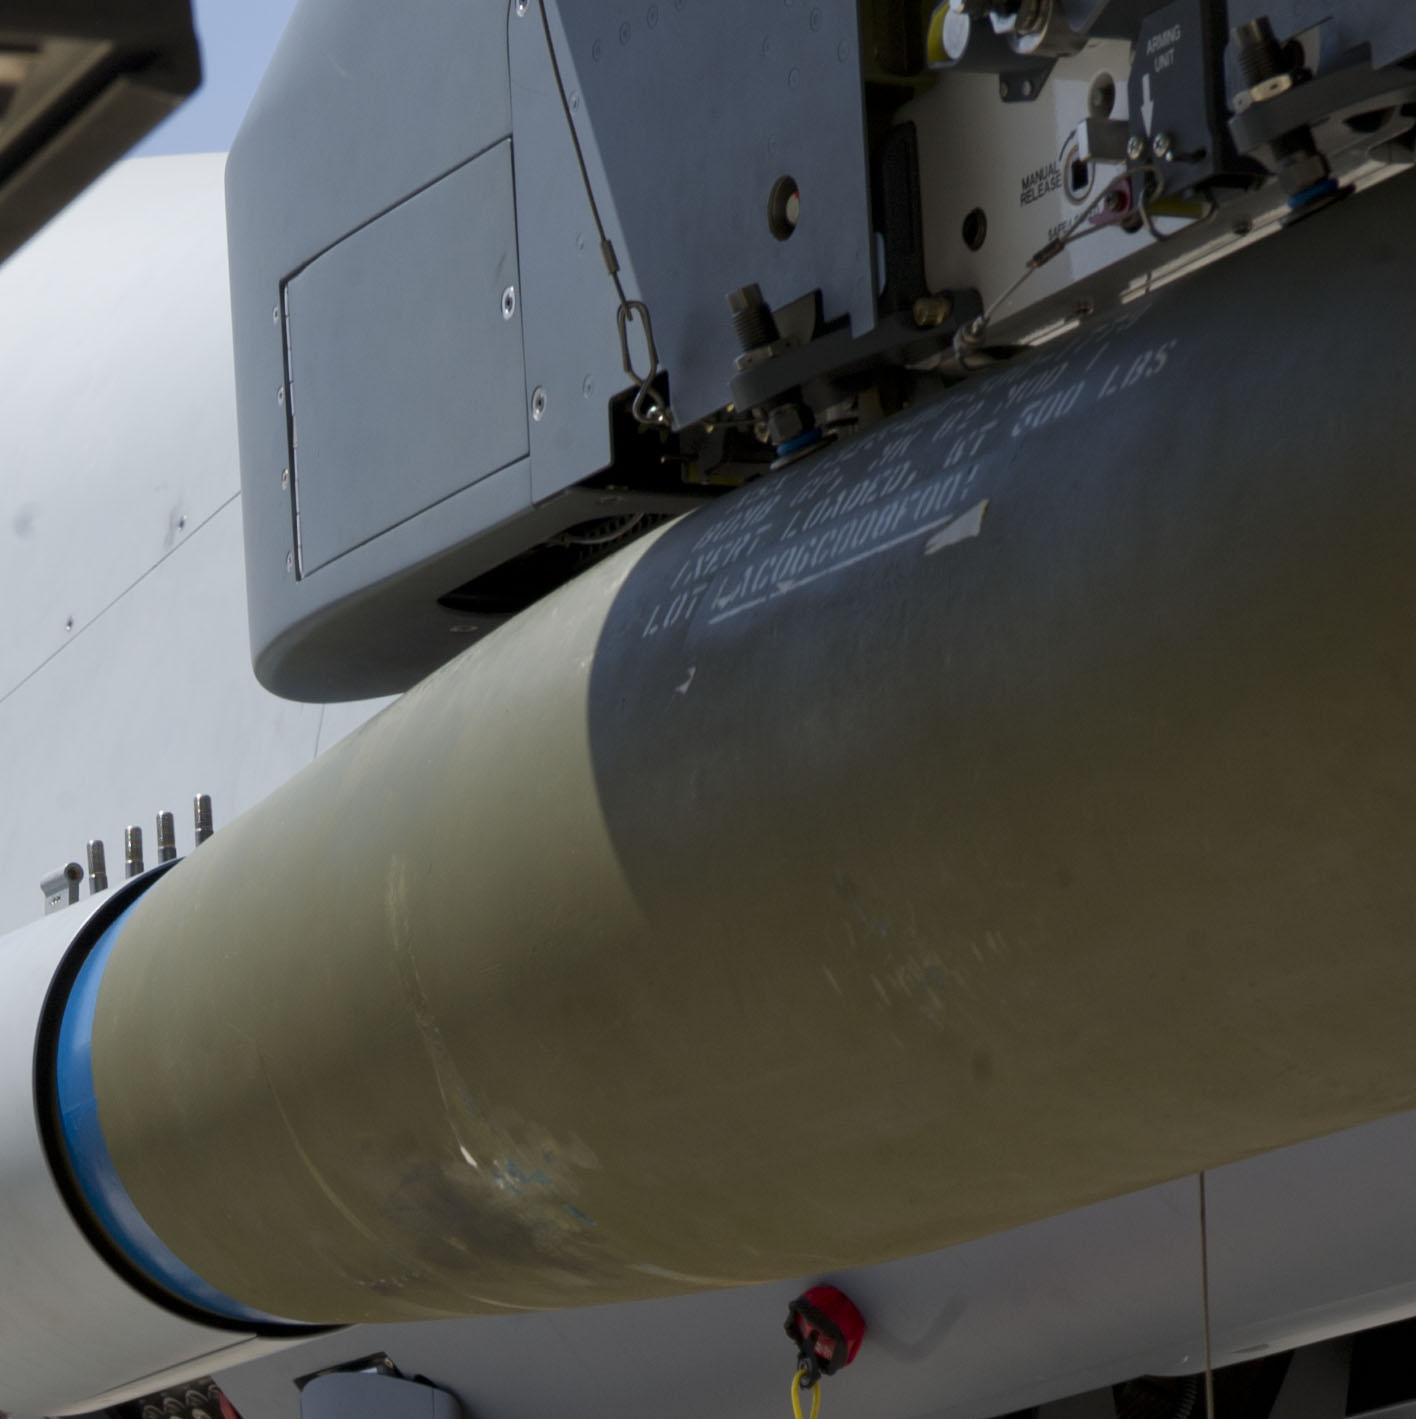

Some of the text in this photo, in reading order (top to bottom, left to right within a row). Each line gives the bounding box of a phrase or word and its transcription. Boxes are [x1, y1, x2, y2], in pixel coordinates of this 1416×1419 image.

[1146, 24, 1181, 55] ARMING
[1154, 48, 1176, 72] UNIT
[1021, 160, 1061, 190] MANUAL
[1020, 175, 1062, 207] RELEASE
[1011, 381, 1085, 437] 500
[1097, 338, 1177, 399] LBS
[643, 583, 707, 637] LOT
